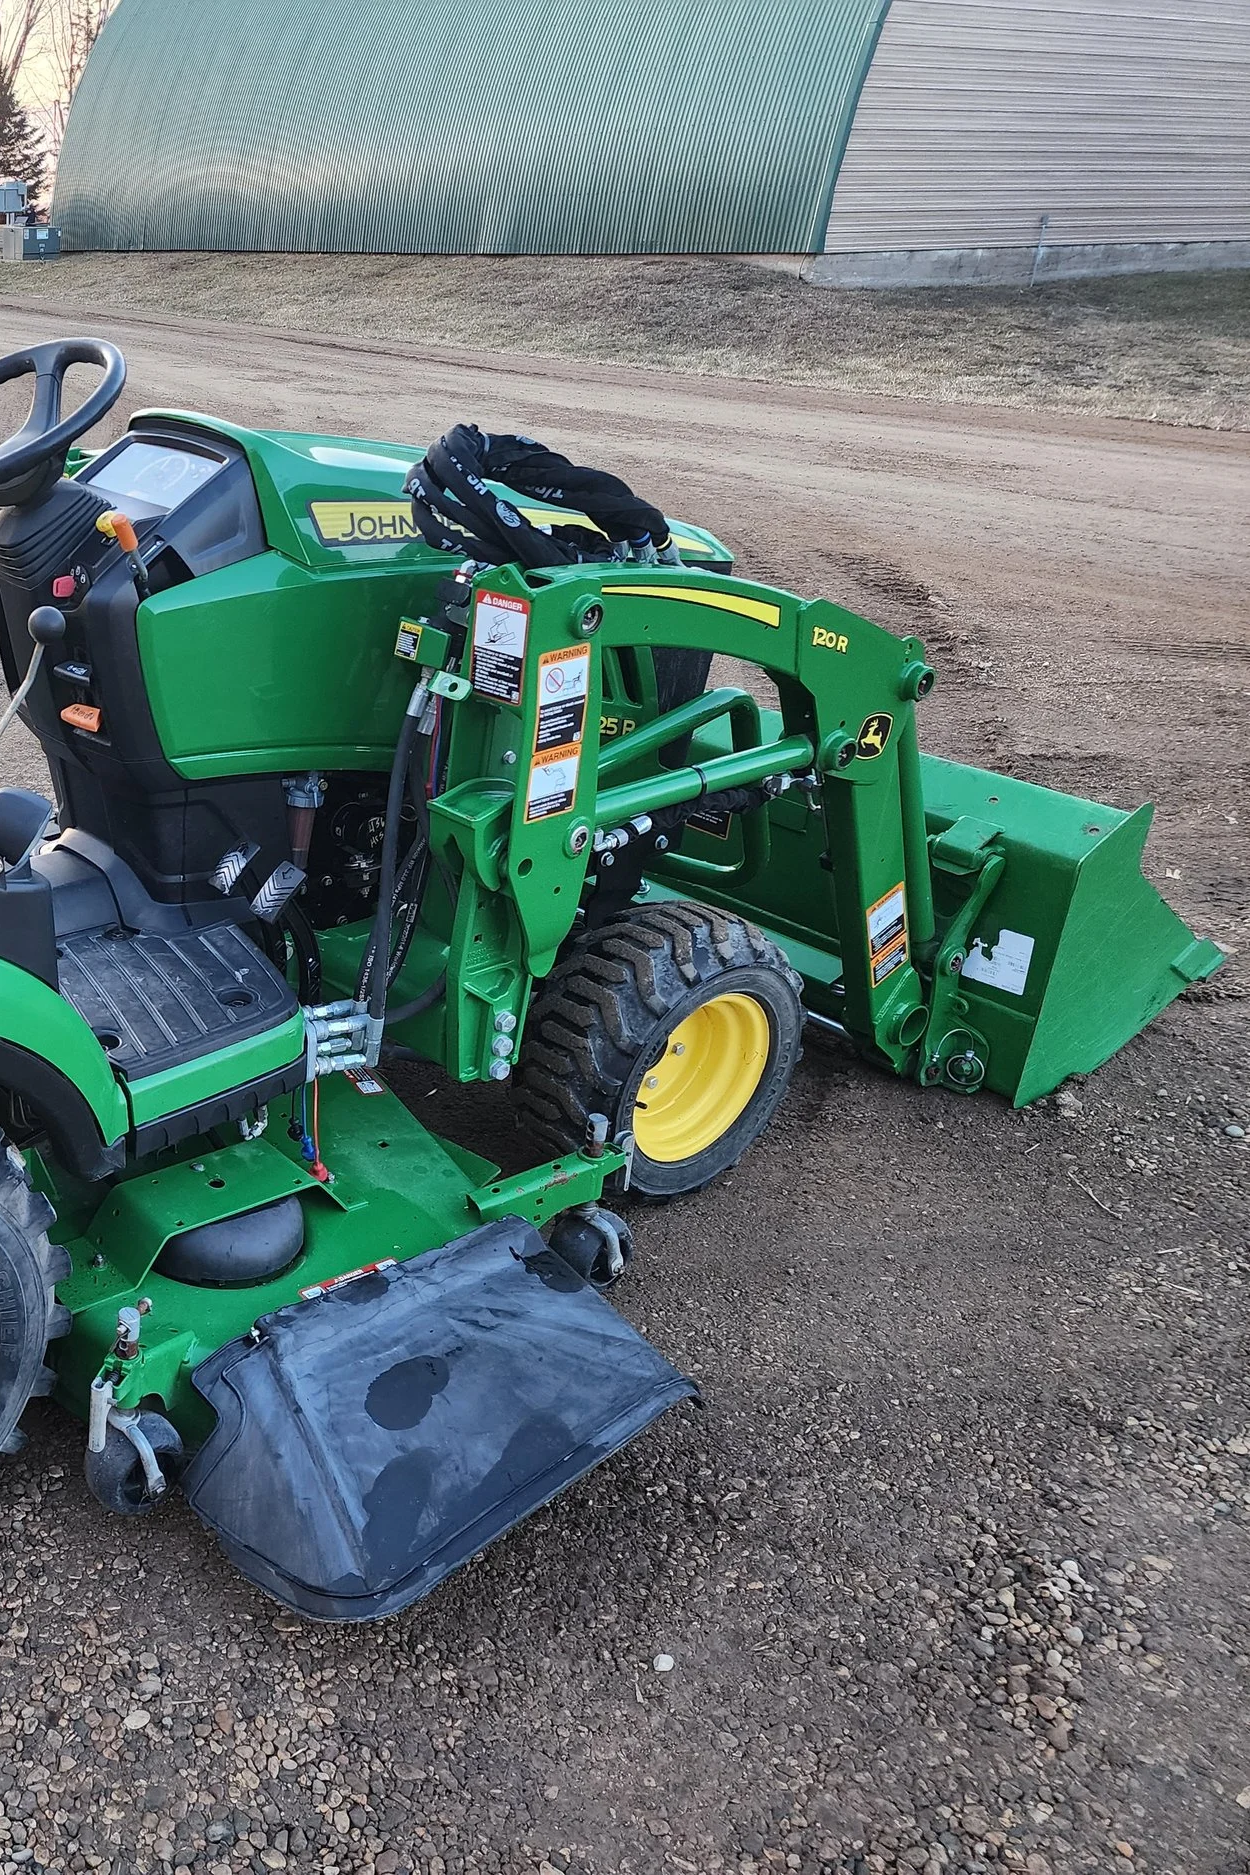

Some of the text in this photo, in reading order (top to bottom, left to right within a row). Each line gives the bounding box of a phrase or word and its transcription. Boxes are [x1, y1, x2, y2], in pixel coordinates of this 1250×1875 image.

[341, 513, 418, 538] JOHN
[492, 596, 524, 612] DANGER
[550, 646, 588, 662] WARNING
[541, 747, 579, 764] WARNING
[366, 954, 375, 967] ISO
